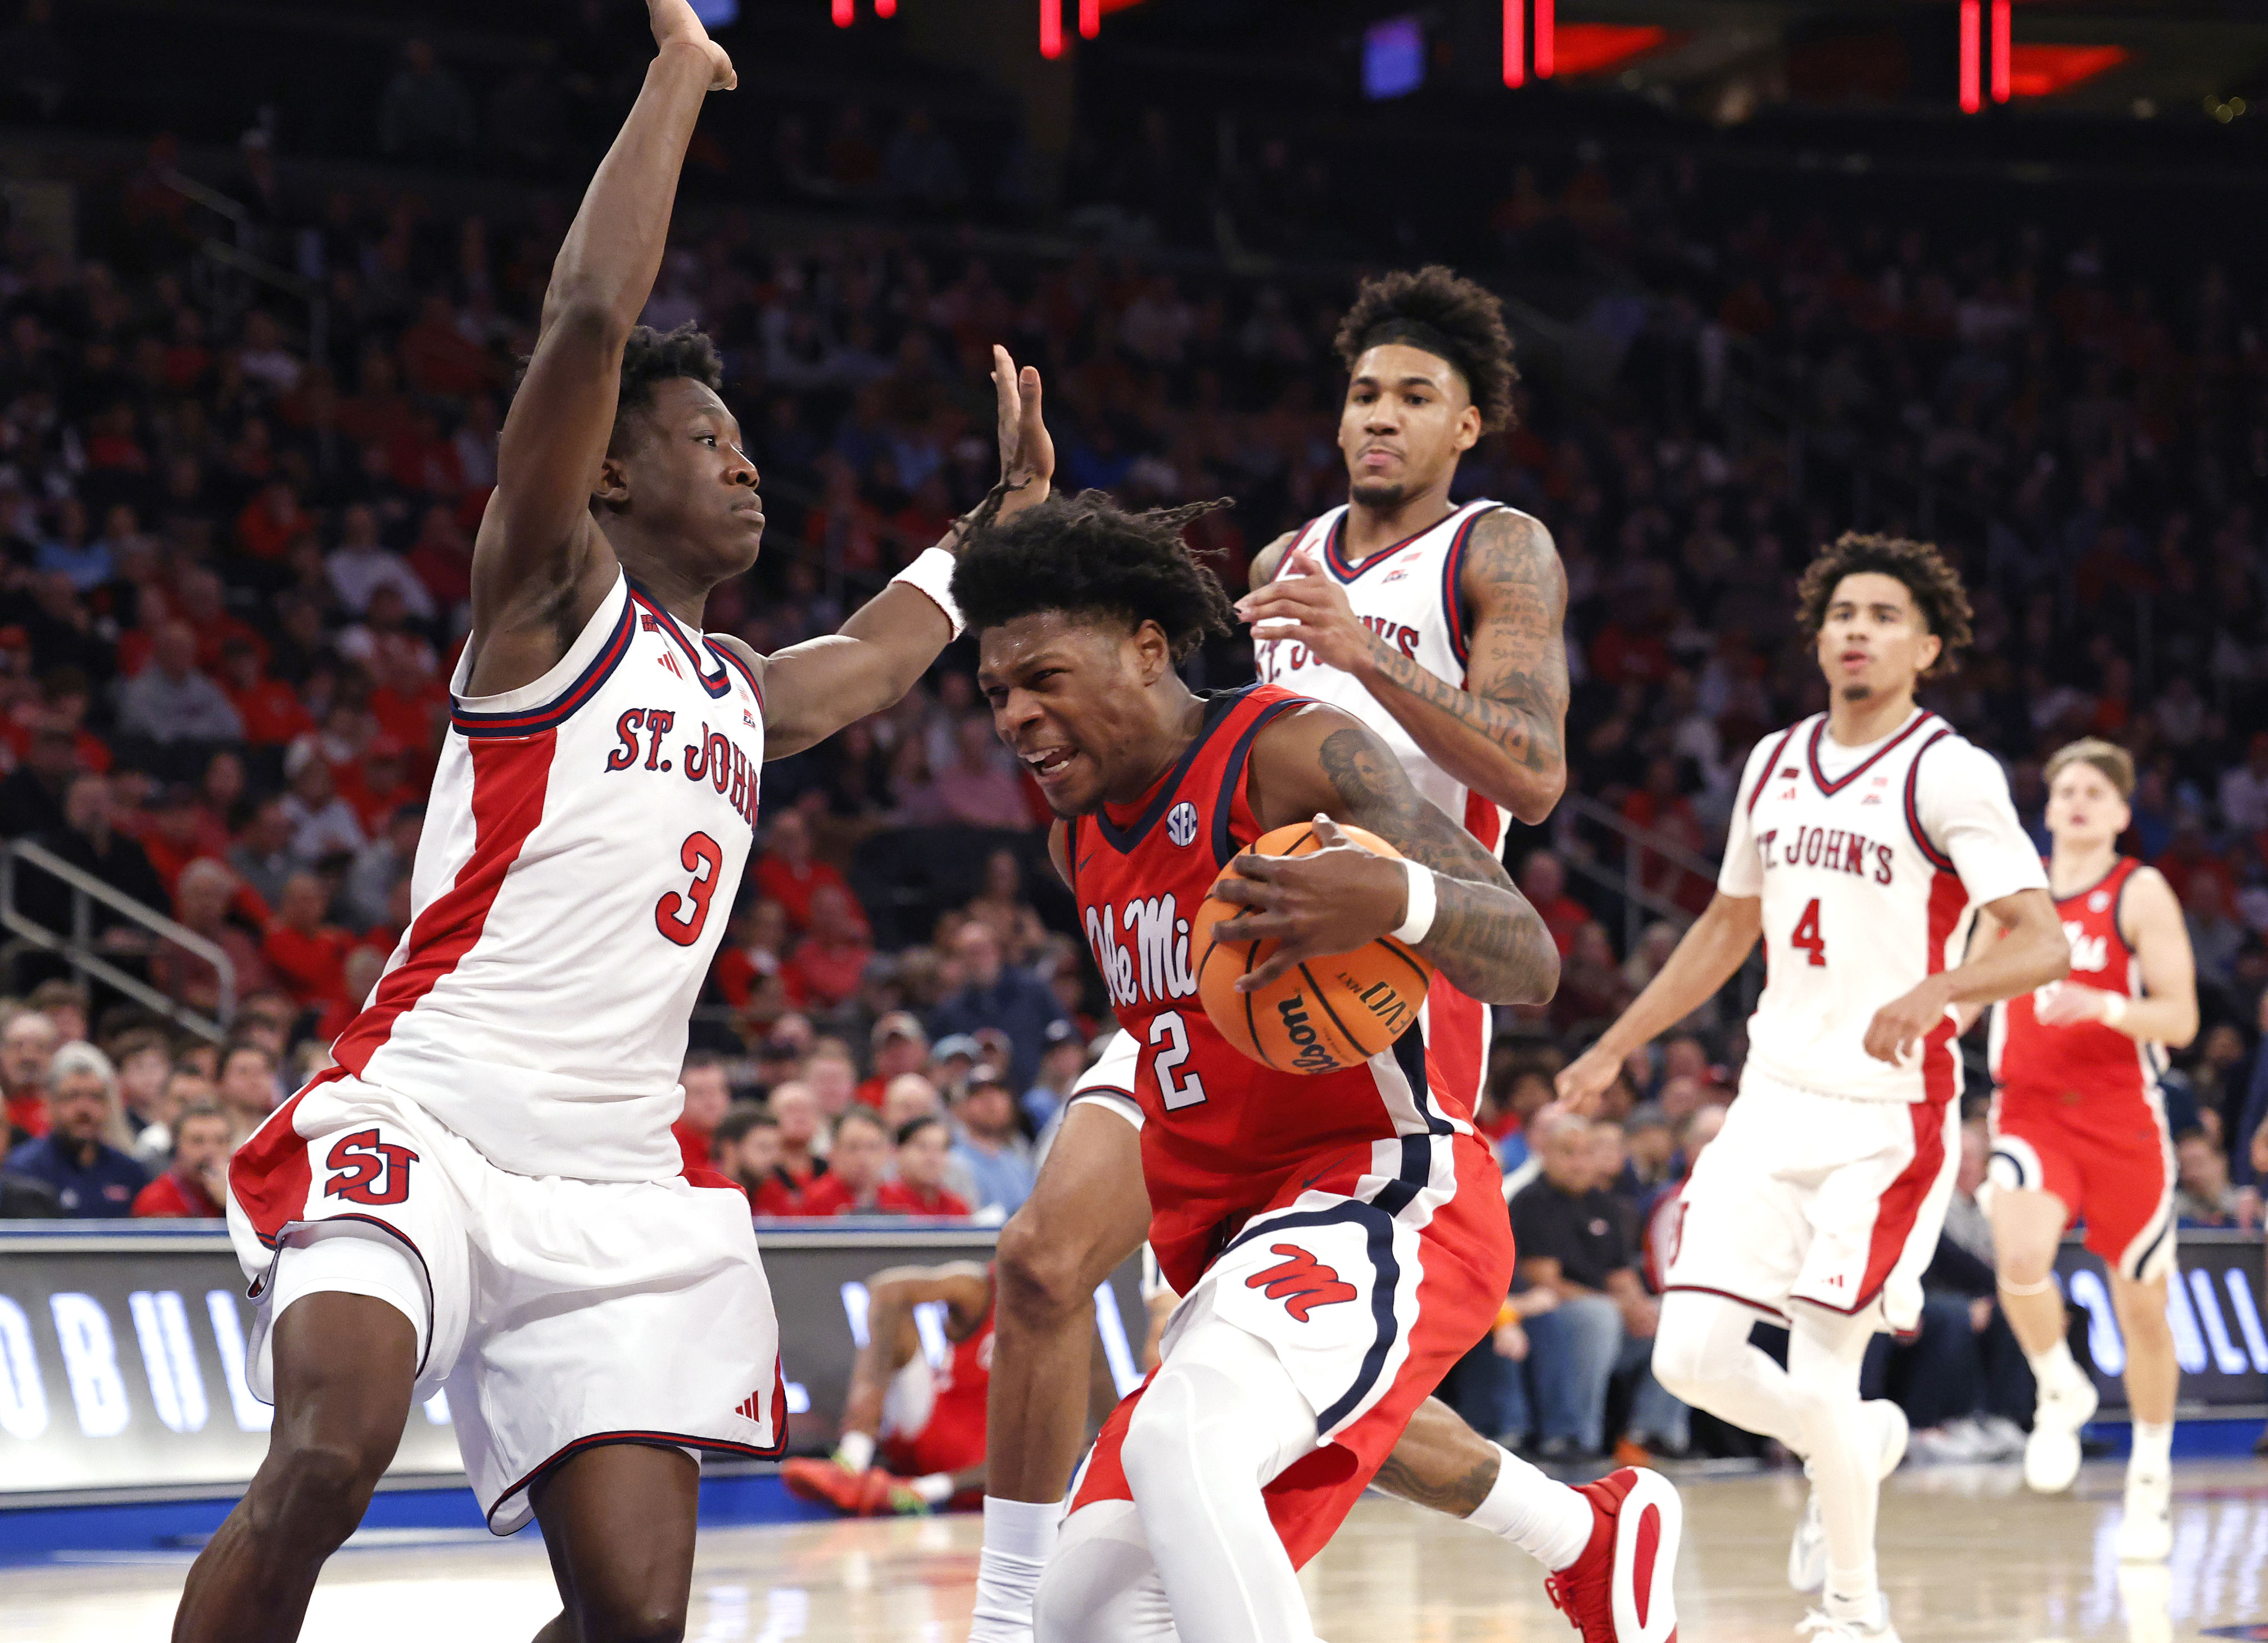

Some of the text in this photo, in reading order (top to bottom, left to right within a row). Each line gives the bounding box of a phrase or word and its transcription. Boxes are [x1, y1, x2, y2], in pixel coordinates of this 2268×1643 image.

[604, 708, 676, 773] ST.
[1166, 801, 1198, 847] SEC
[1785, 825, 1894, 885] JOHN'S
[655, 830, 723, 947] 3
[1791, 898, 1826, 967] 4
[1149, 1008, 1208, 1114] 2
